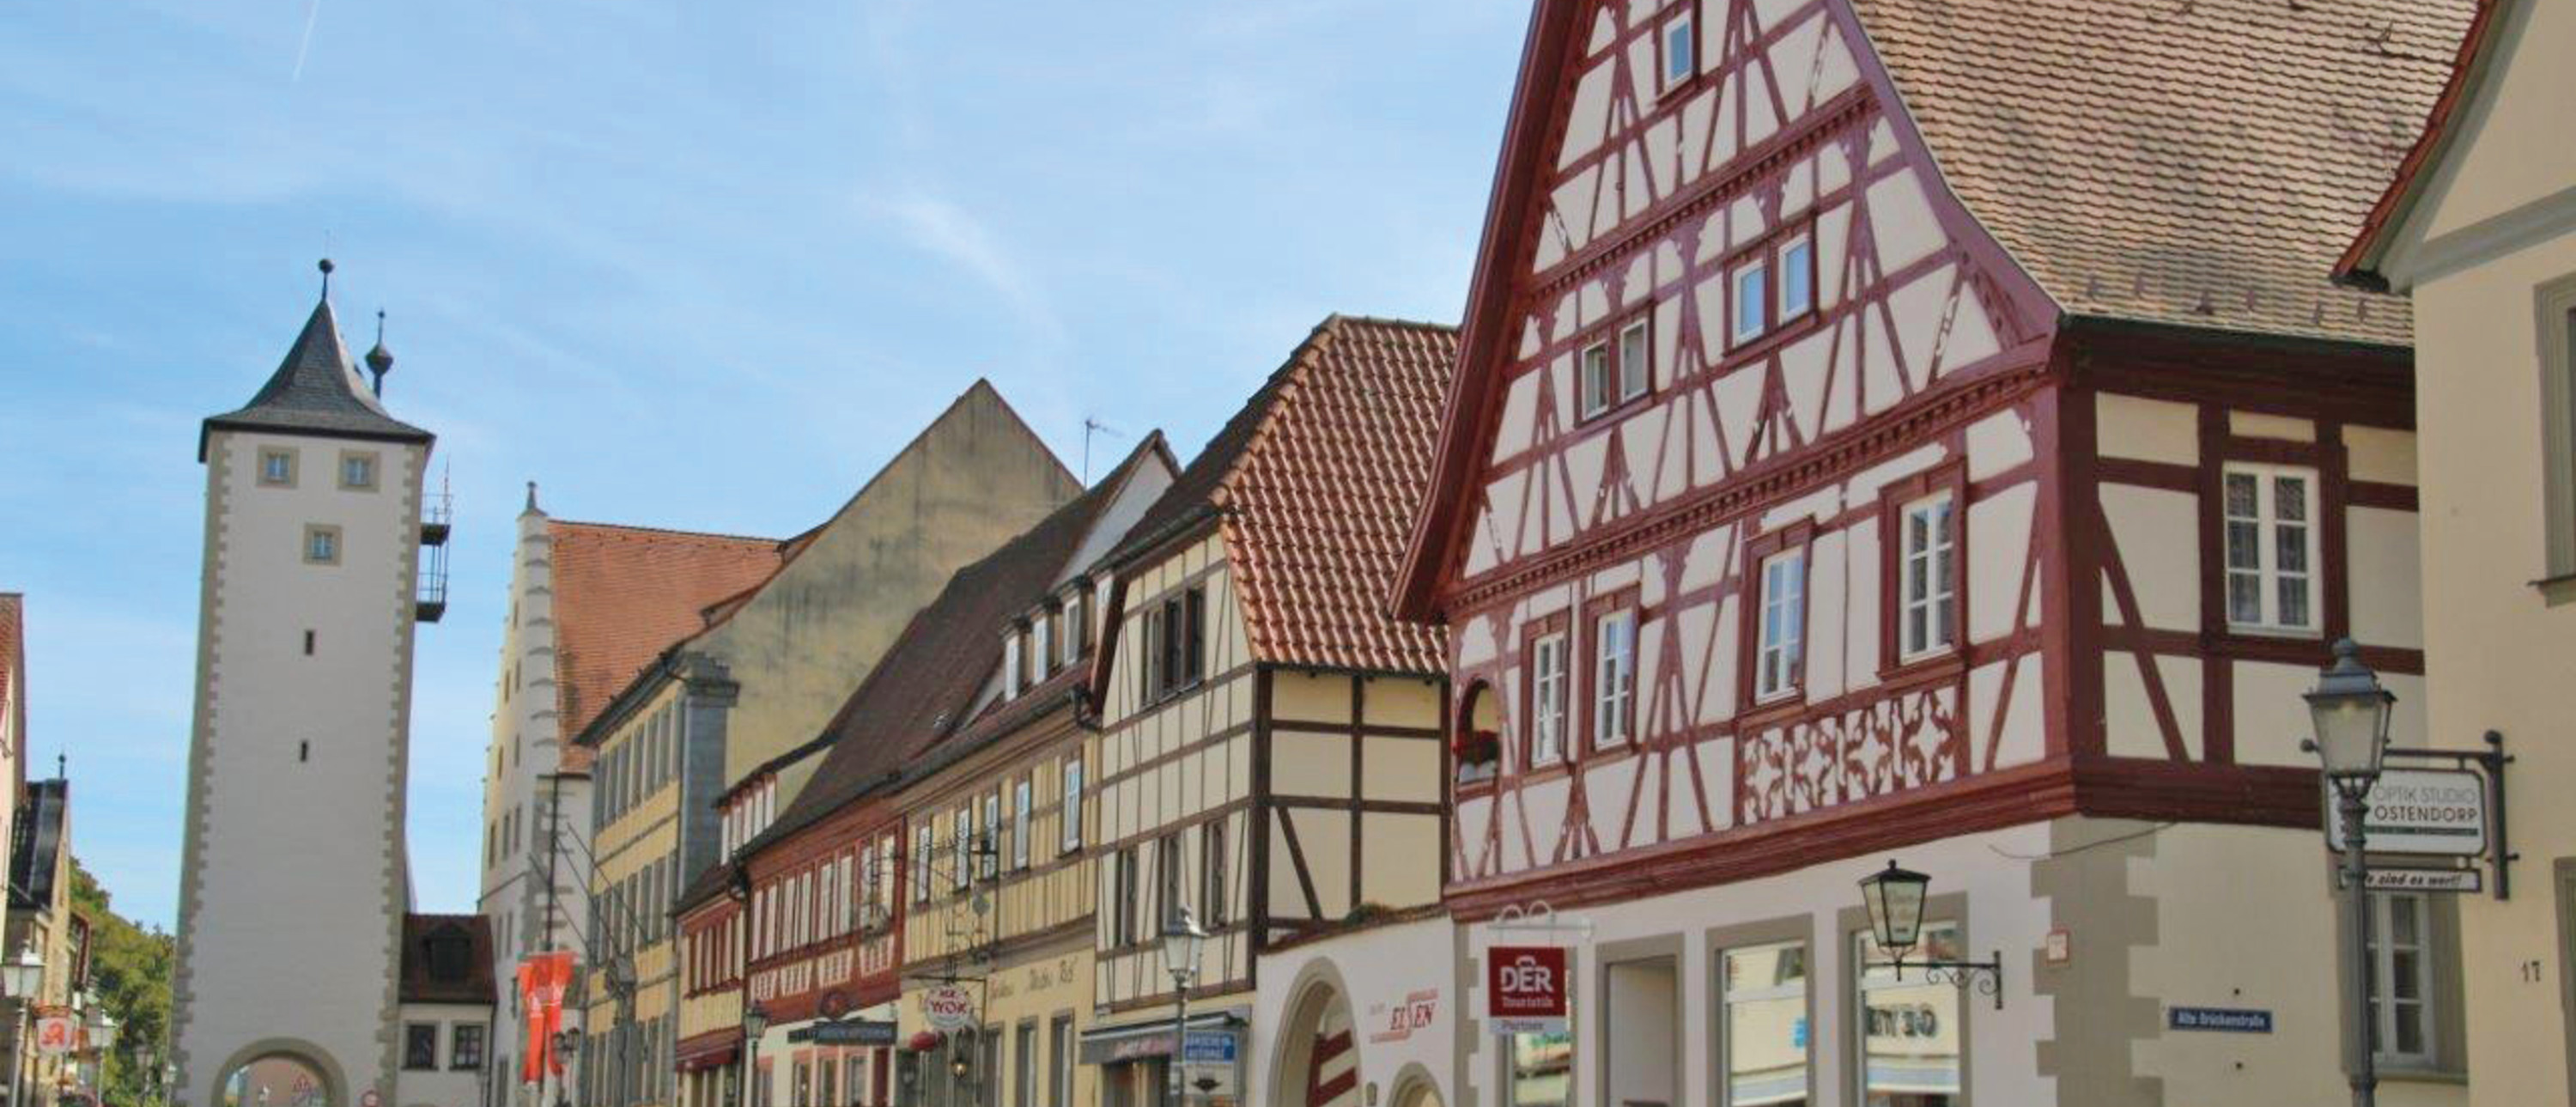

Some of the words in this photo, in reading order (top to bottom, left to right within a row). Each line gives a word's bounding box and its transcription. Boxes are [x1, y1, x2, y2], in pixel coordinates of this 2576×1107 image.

[2373, 785, 2418, 803] OPTIK
[2420, 787, 2477, 804] STUDIO
[2374, 805, 2478, 822] OSTENDORP
[1500, 966, 1553, 992] DER
[2521, 960, 2542, 982] 17
[932, 1001, 968, 1014] WOK
